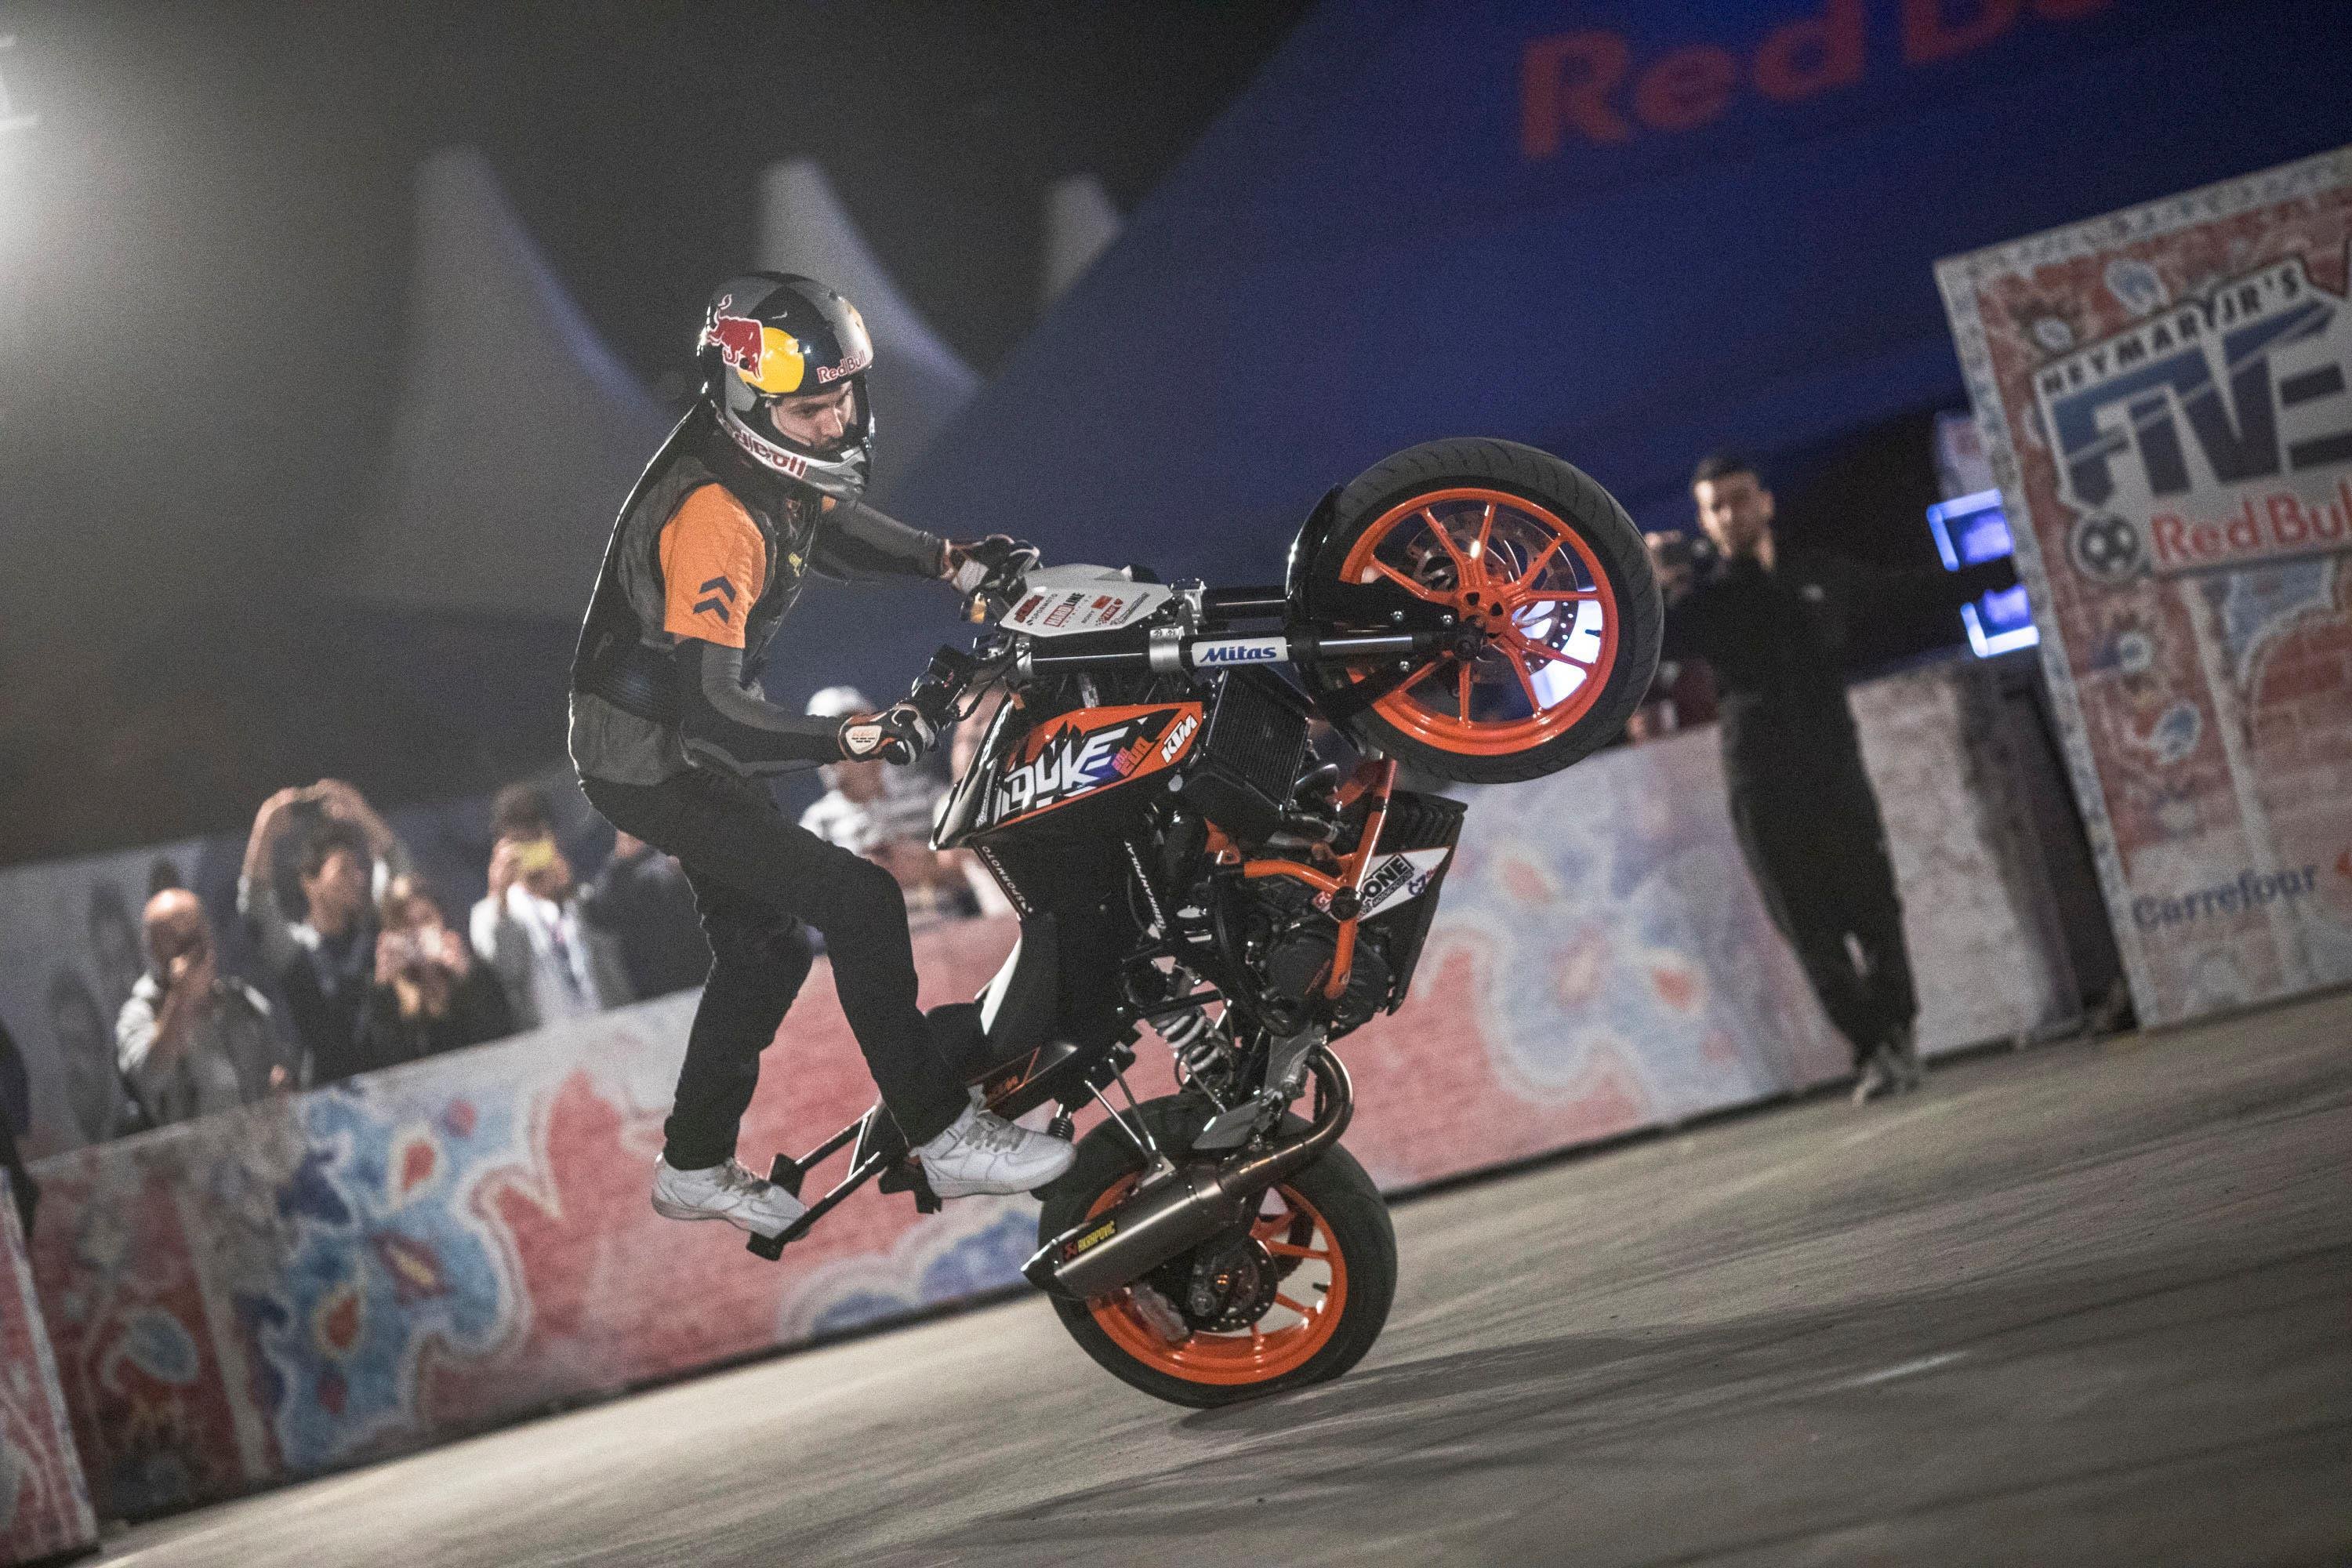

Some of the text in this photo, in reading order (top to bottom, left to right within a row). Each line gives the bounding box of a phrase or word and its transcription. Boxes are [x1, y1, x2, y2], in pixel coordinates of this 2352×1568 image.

[1522, 0, 1864, 157] Red
[2148, 496, 2262, 562] Red
[1200, 645, 1276, 663] Mitas
[1160, 713, 1198, 764] KTM
[999, 726, 1129, 818] DUKE
[982, 844, 1025, 904] SPORMOTO
